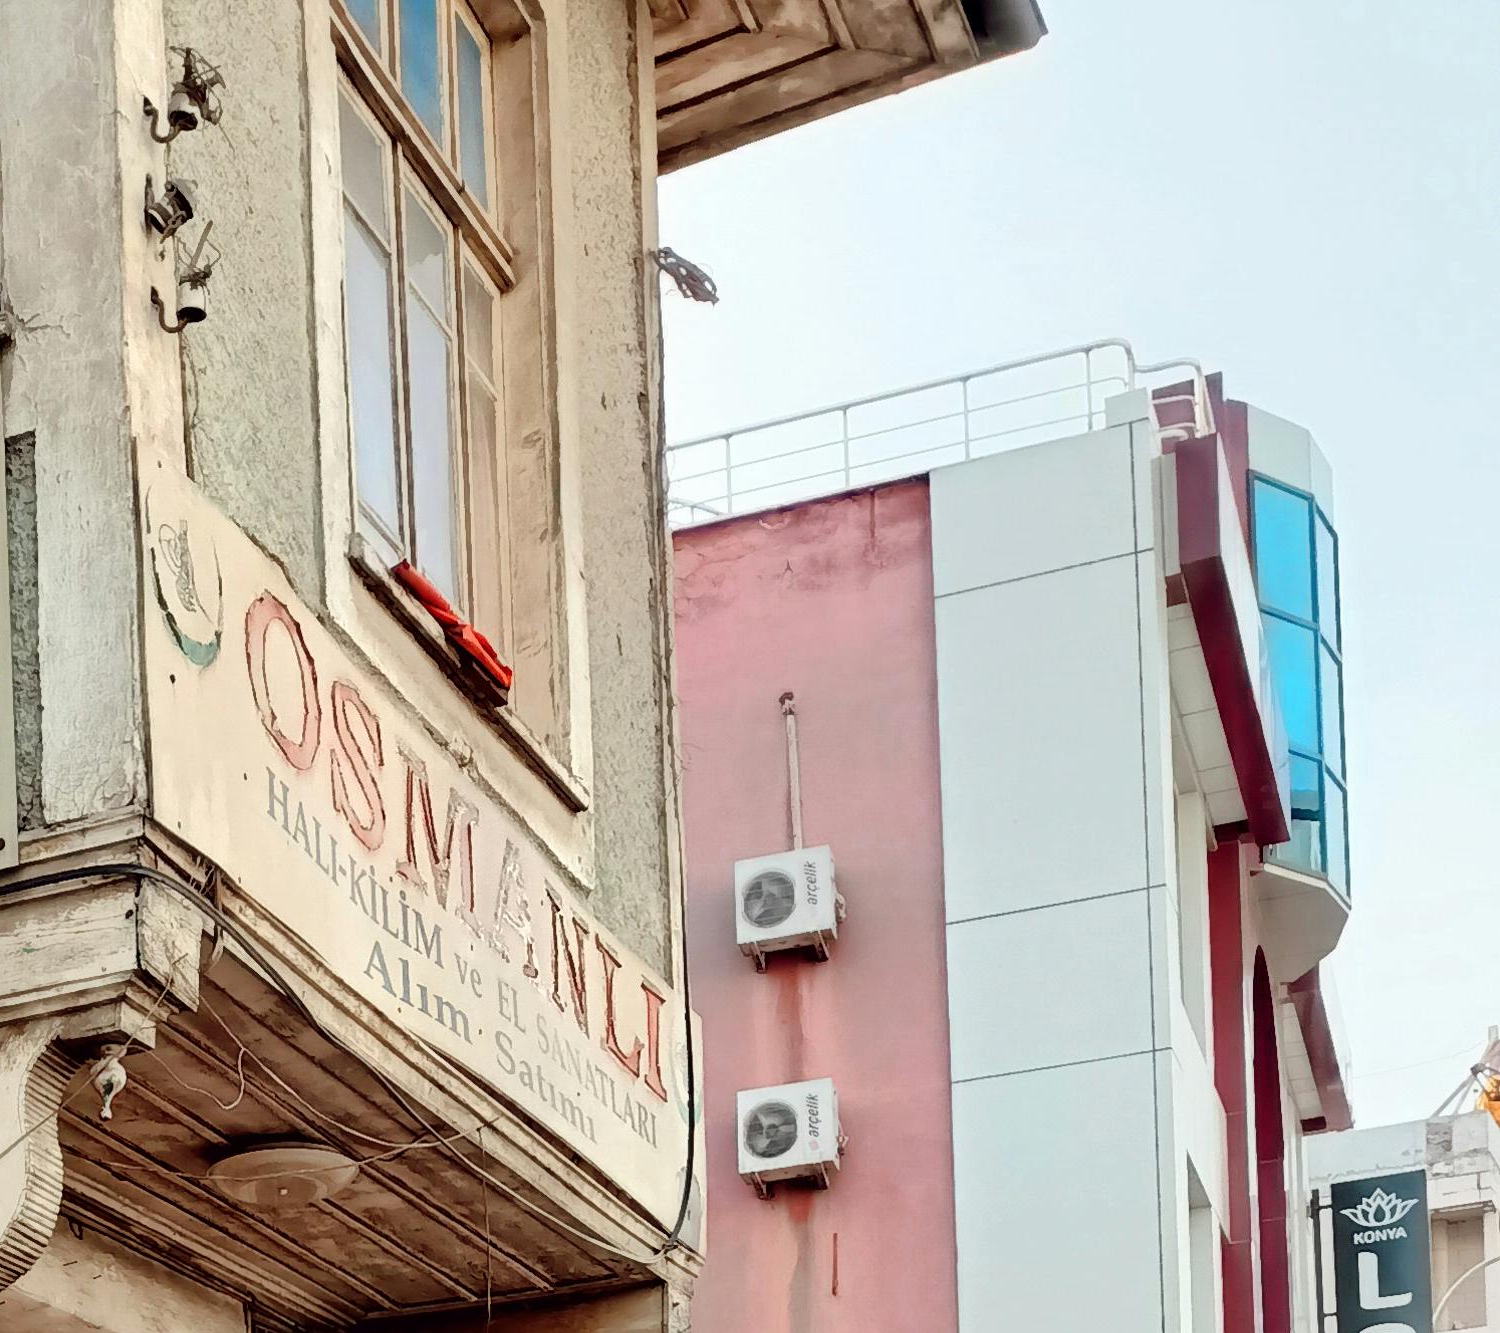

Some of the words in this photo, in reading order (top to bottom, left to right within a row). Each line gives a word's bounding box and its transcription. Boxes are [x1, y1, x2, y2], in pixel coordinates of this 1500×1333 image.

[245, 590, 668, 1102] OSMANLI
[804, 860, 820, 905] arçelik
[363, 940, 473, 1045] Alım
[495, 1030, 598, 1145] Satımı
[454, 952, 483, 999] ve
[498, 977, 526, 1035] EL
[536, 1012, 658, 1149] SANATLARI
[805, 1093, 822, 1138] arçelik
[1353, 1226, 1407, 1246] KONYA
